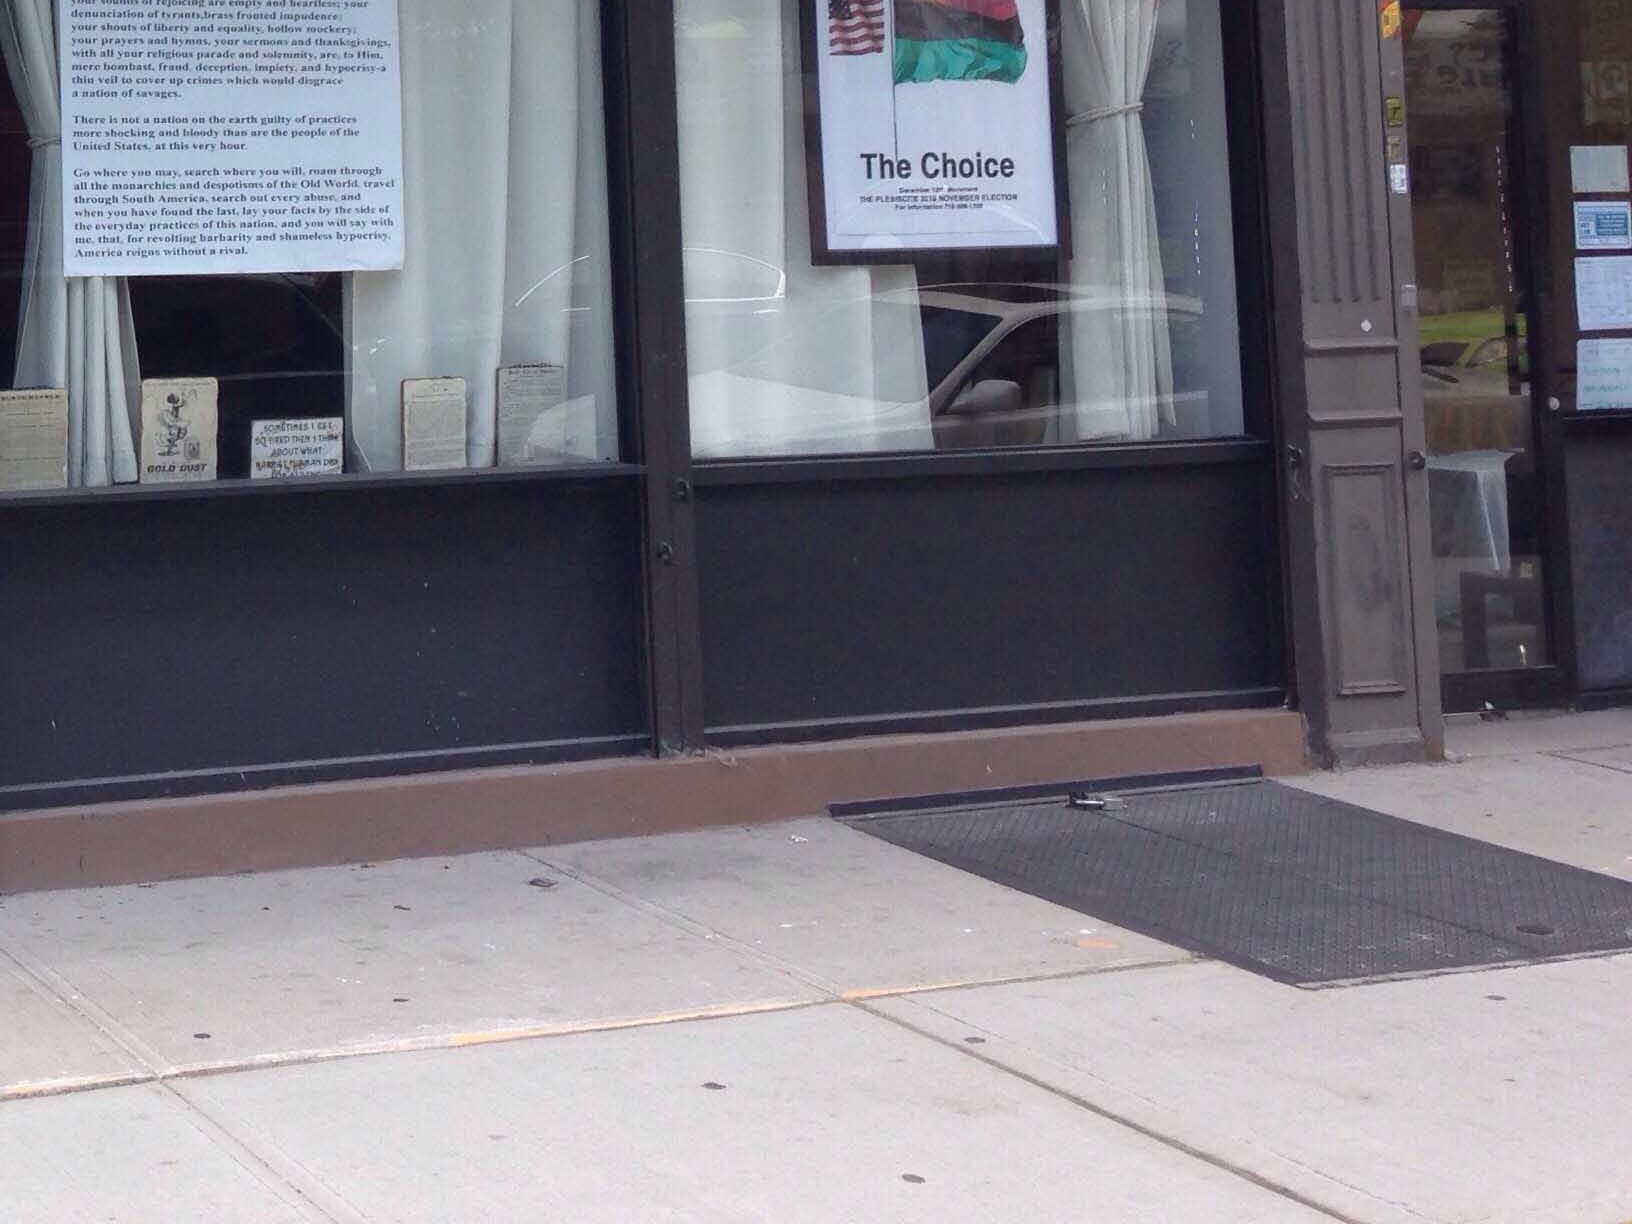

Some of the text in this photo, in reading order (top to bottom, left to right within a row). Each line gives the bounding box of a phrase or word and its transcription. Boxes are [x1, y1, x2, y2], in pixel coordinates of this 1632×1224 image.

[860, 151, 1015, 179] The Choice
[147, 463, 208, 473] GOLD DUST
